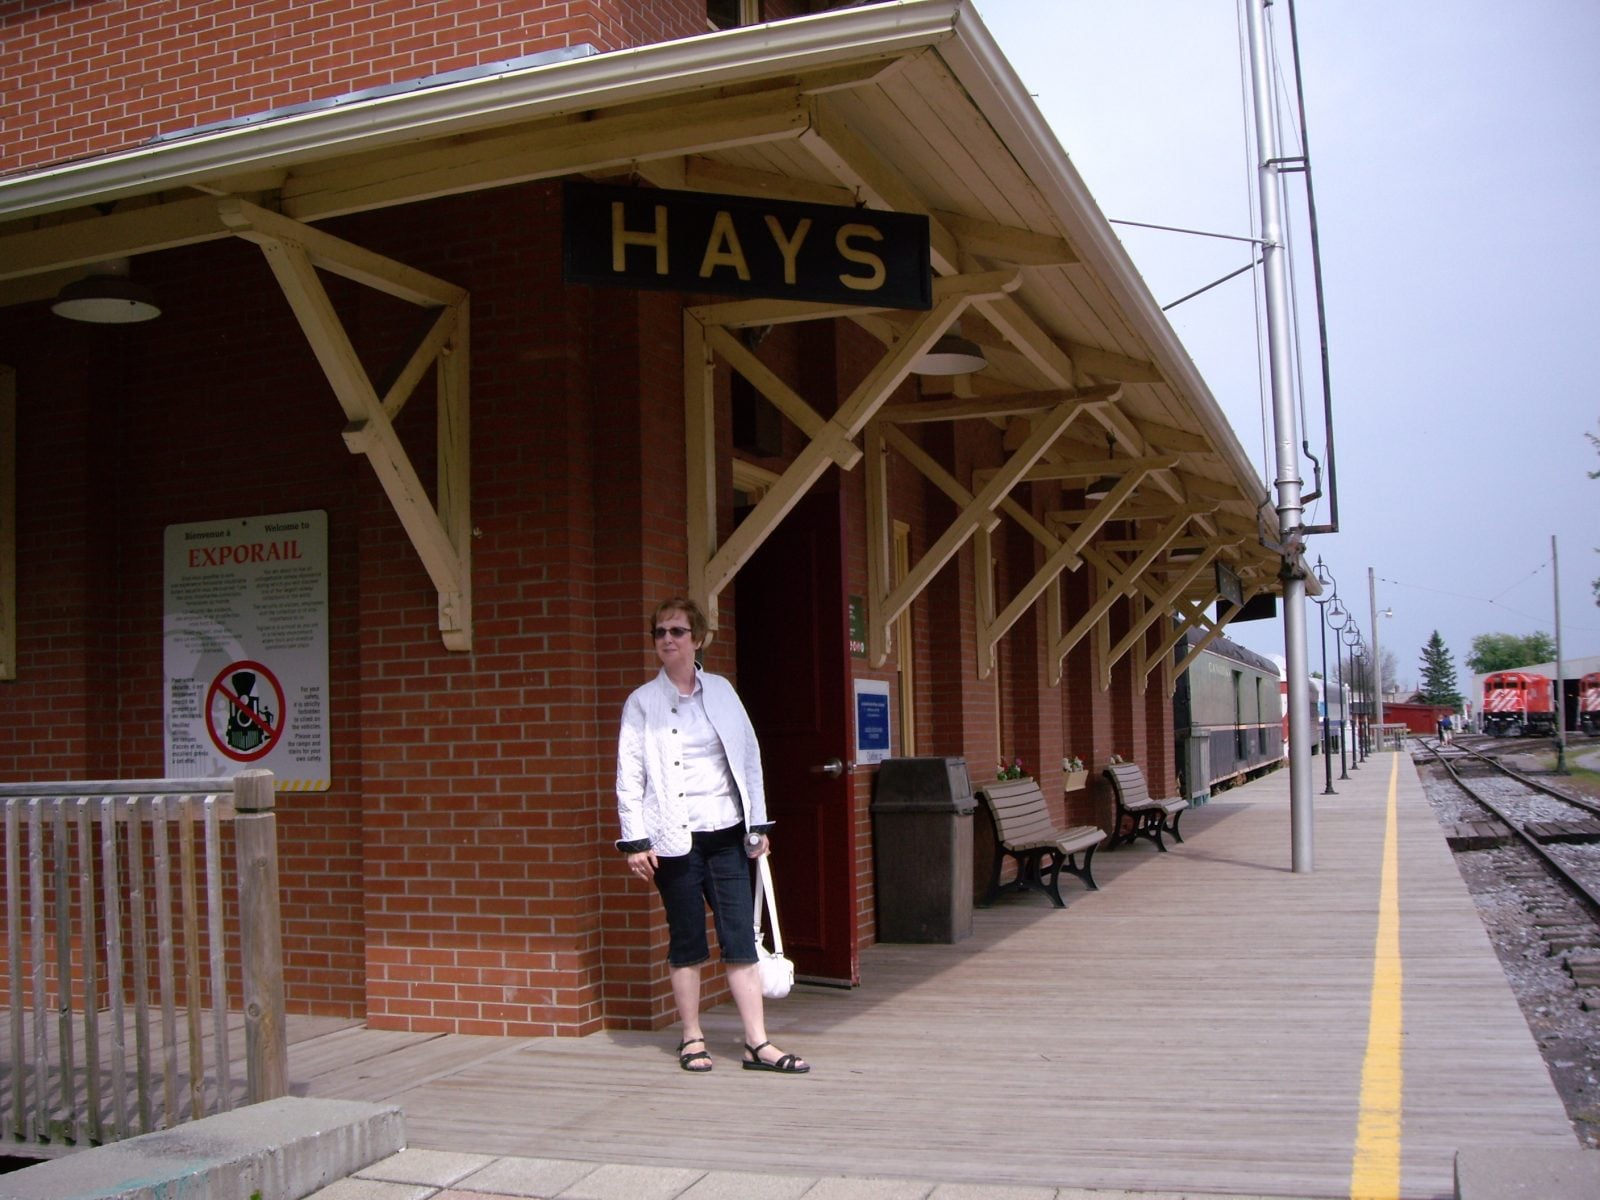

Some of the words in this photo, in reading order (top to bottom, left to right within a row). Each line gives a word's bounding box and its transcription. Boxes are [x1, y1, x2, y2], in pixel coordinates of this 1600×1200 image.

[612, 201, 887, 290] HAYS
[184, 531, 224, 541] Bienvenue
[264, 522, 299, 533] Welcome
[301, 521, 309, 530] to
[188, 540, 302, 568] EXPORAIL
